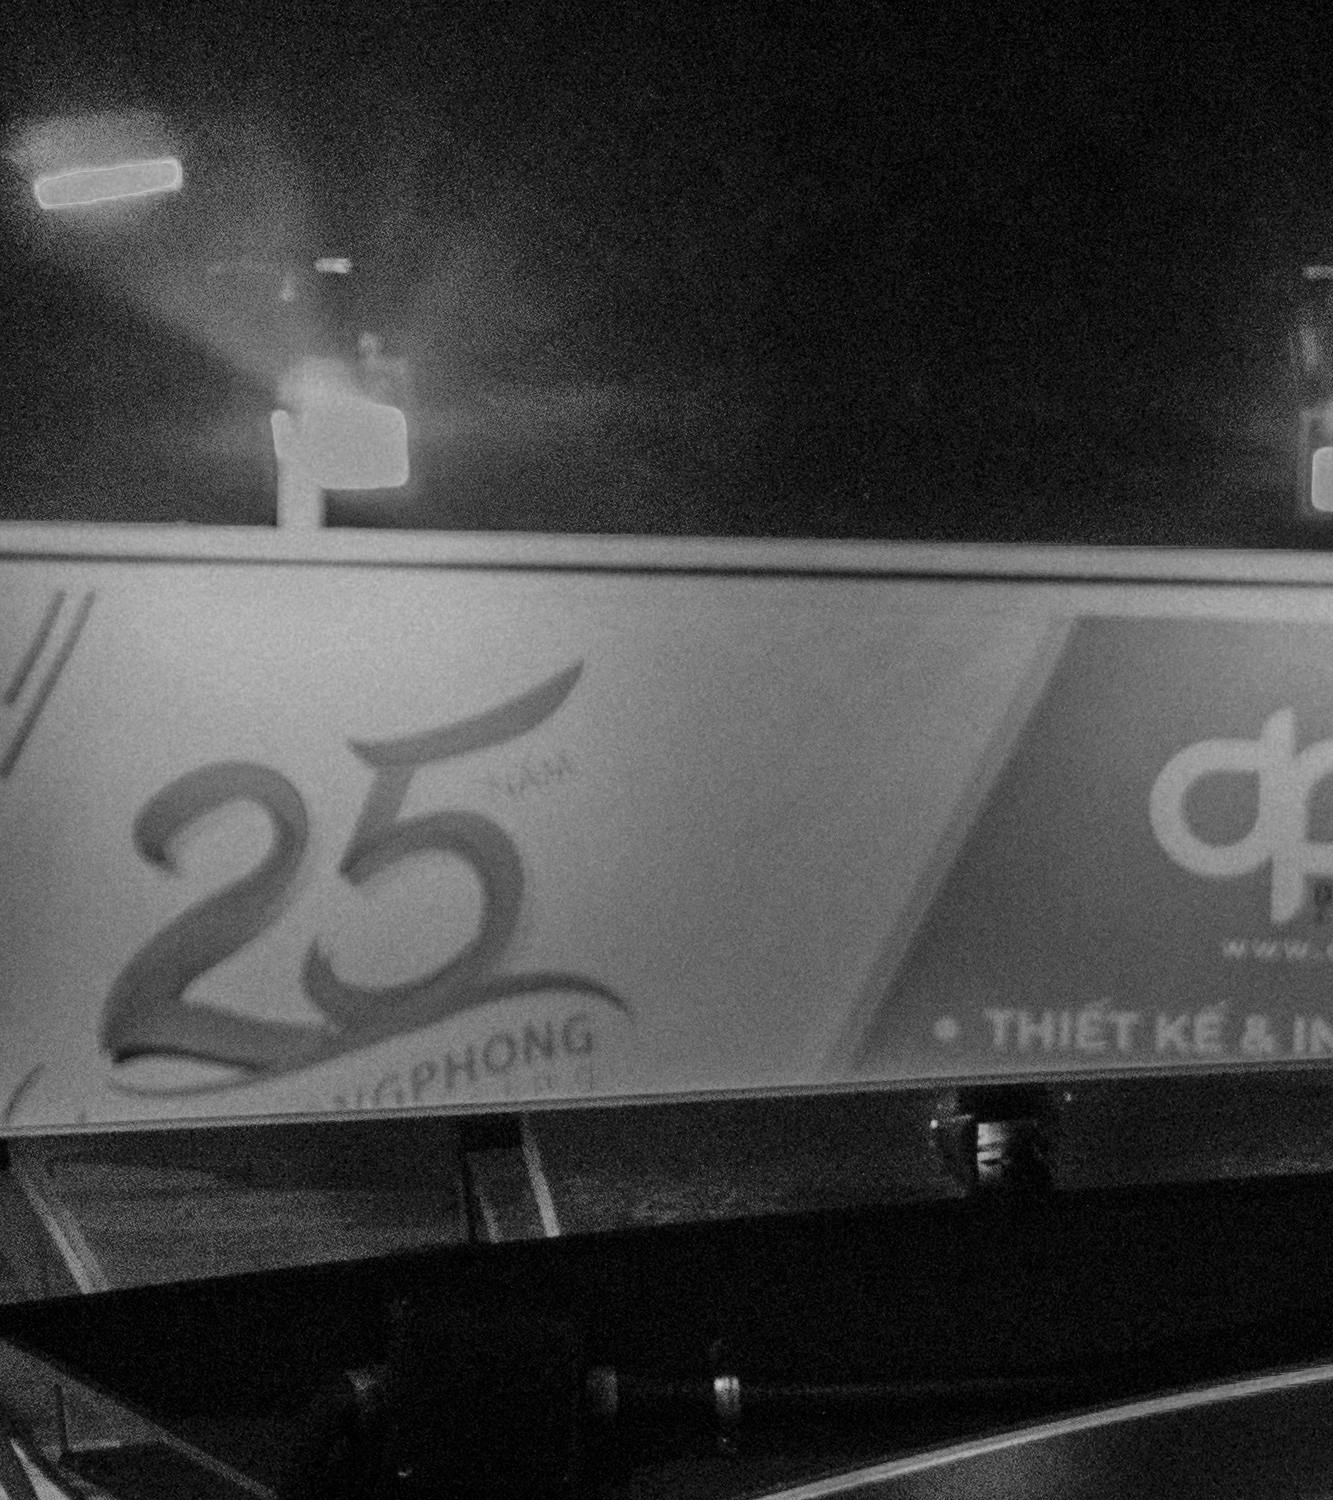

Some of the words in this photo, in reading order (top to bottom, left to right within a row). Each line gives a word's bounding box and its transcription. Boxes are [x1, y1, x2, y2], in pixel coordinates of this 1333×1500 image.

[100, 658, 630, 1078] 25
[984, 997, 1140, 1054] THIẾT
[1155, 998, 1231, 1055] KẾ
[1240, 1014, 1277, 1056] &
